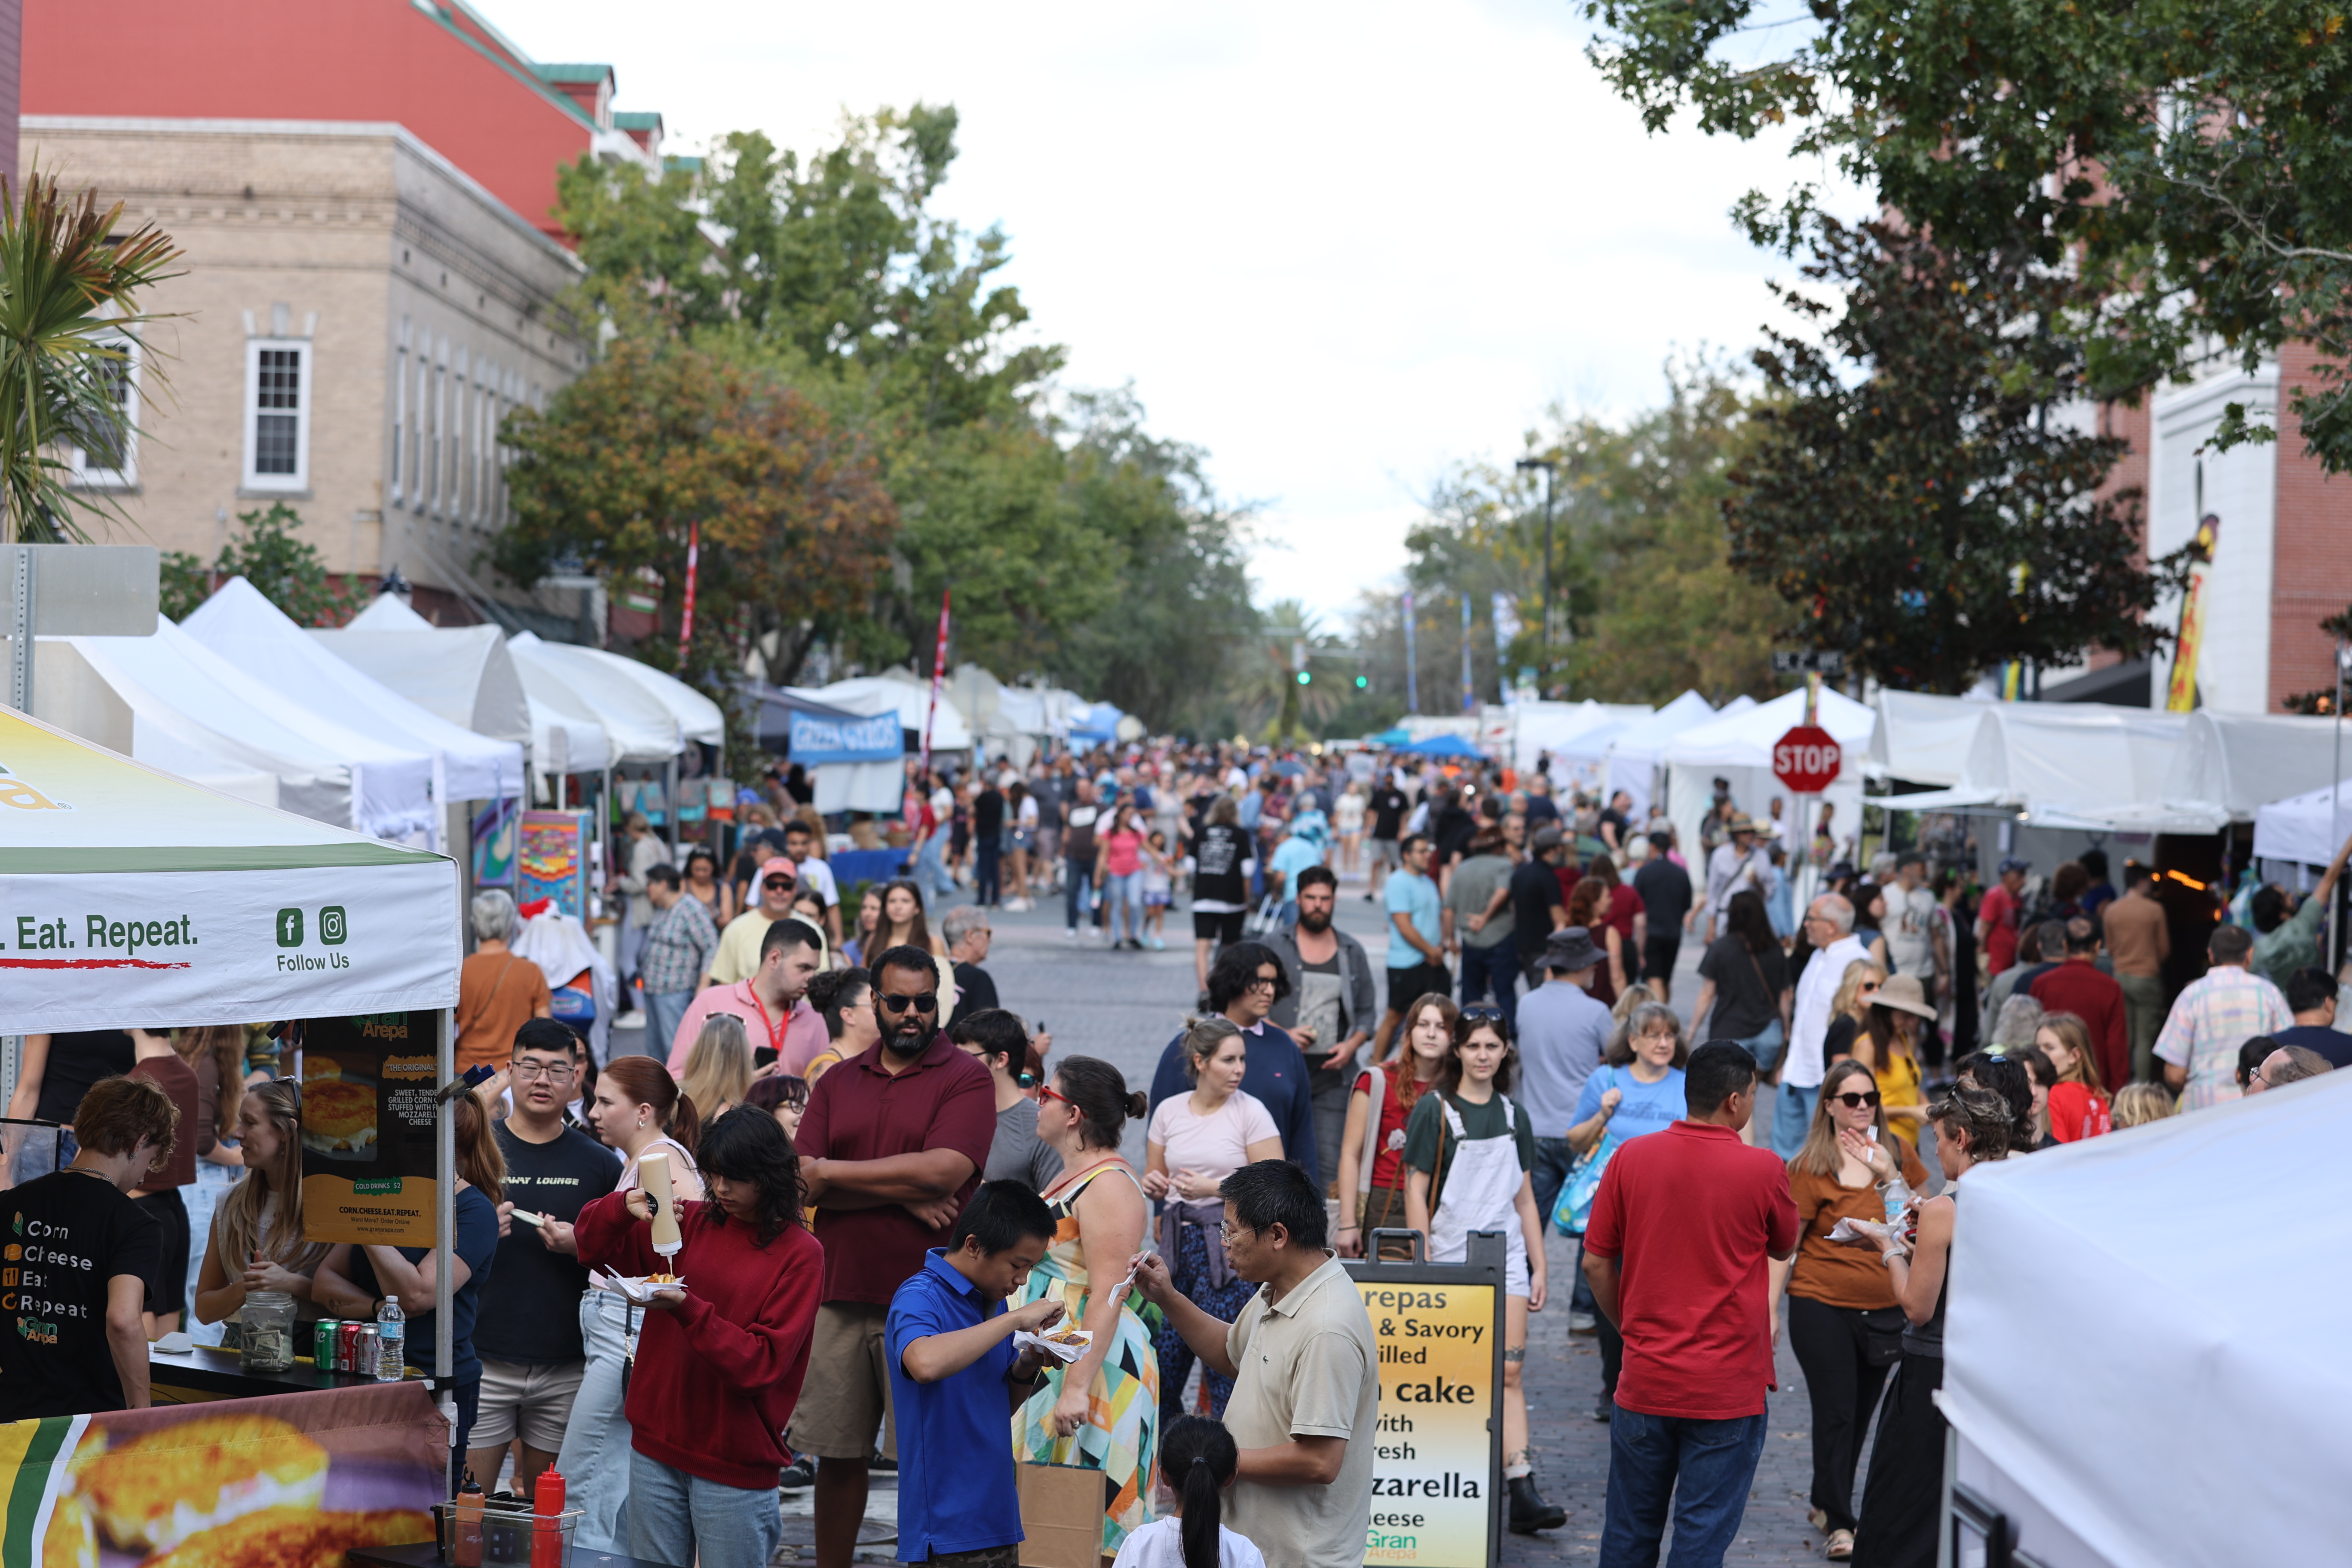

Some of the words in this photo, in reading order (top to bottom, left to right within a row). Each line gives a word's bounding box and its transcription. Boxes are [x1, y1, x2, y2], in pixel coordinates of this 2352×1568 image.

[1776, 744, 1839, 775] STOP
[17, 916, 75, 949] Eat.
[86, 915, 198, 956] Repeat.
[277, 954, 325, 971] Follow
[330, 952, 349, 969] Us
[362, 1021, 408, 1041] Arepa
[386, 1064, 401, 1072] "THE
[536, 1177, 579, 1186] LOUNGE
[339, 1206, 421, 1217] CORN.CHEESE.EAT.REPEAT.
[28, 1220, 68, 1240] Corn
[24, 1246, 93, 1271] Cheese
[23, 1271, 48, 1288] Eat
[21, 1295, 87, 1318] Repeat
[1364, 1290, 1447, 1315] repas
[1379, 1318, 1396, 1336] &
[1405, 1318, 1485, 1344] Savory
[1377, 1344, 1427, 1364] illed
[1396, 1376, 1475, 1404] cake
[1374, 1442, 1415, 1460] esh
[1369, 1513, 1425, 1527] eese
[1366, 1529, 1417, 1549] Gran
[1369, 1545, 1417, 1561] Arepa
